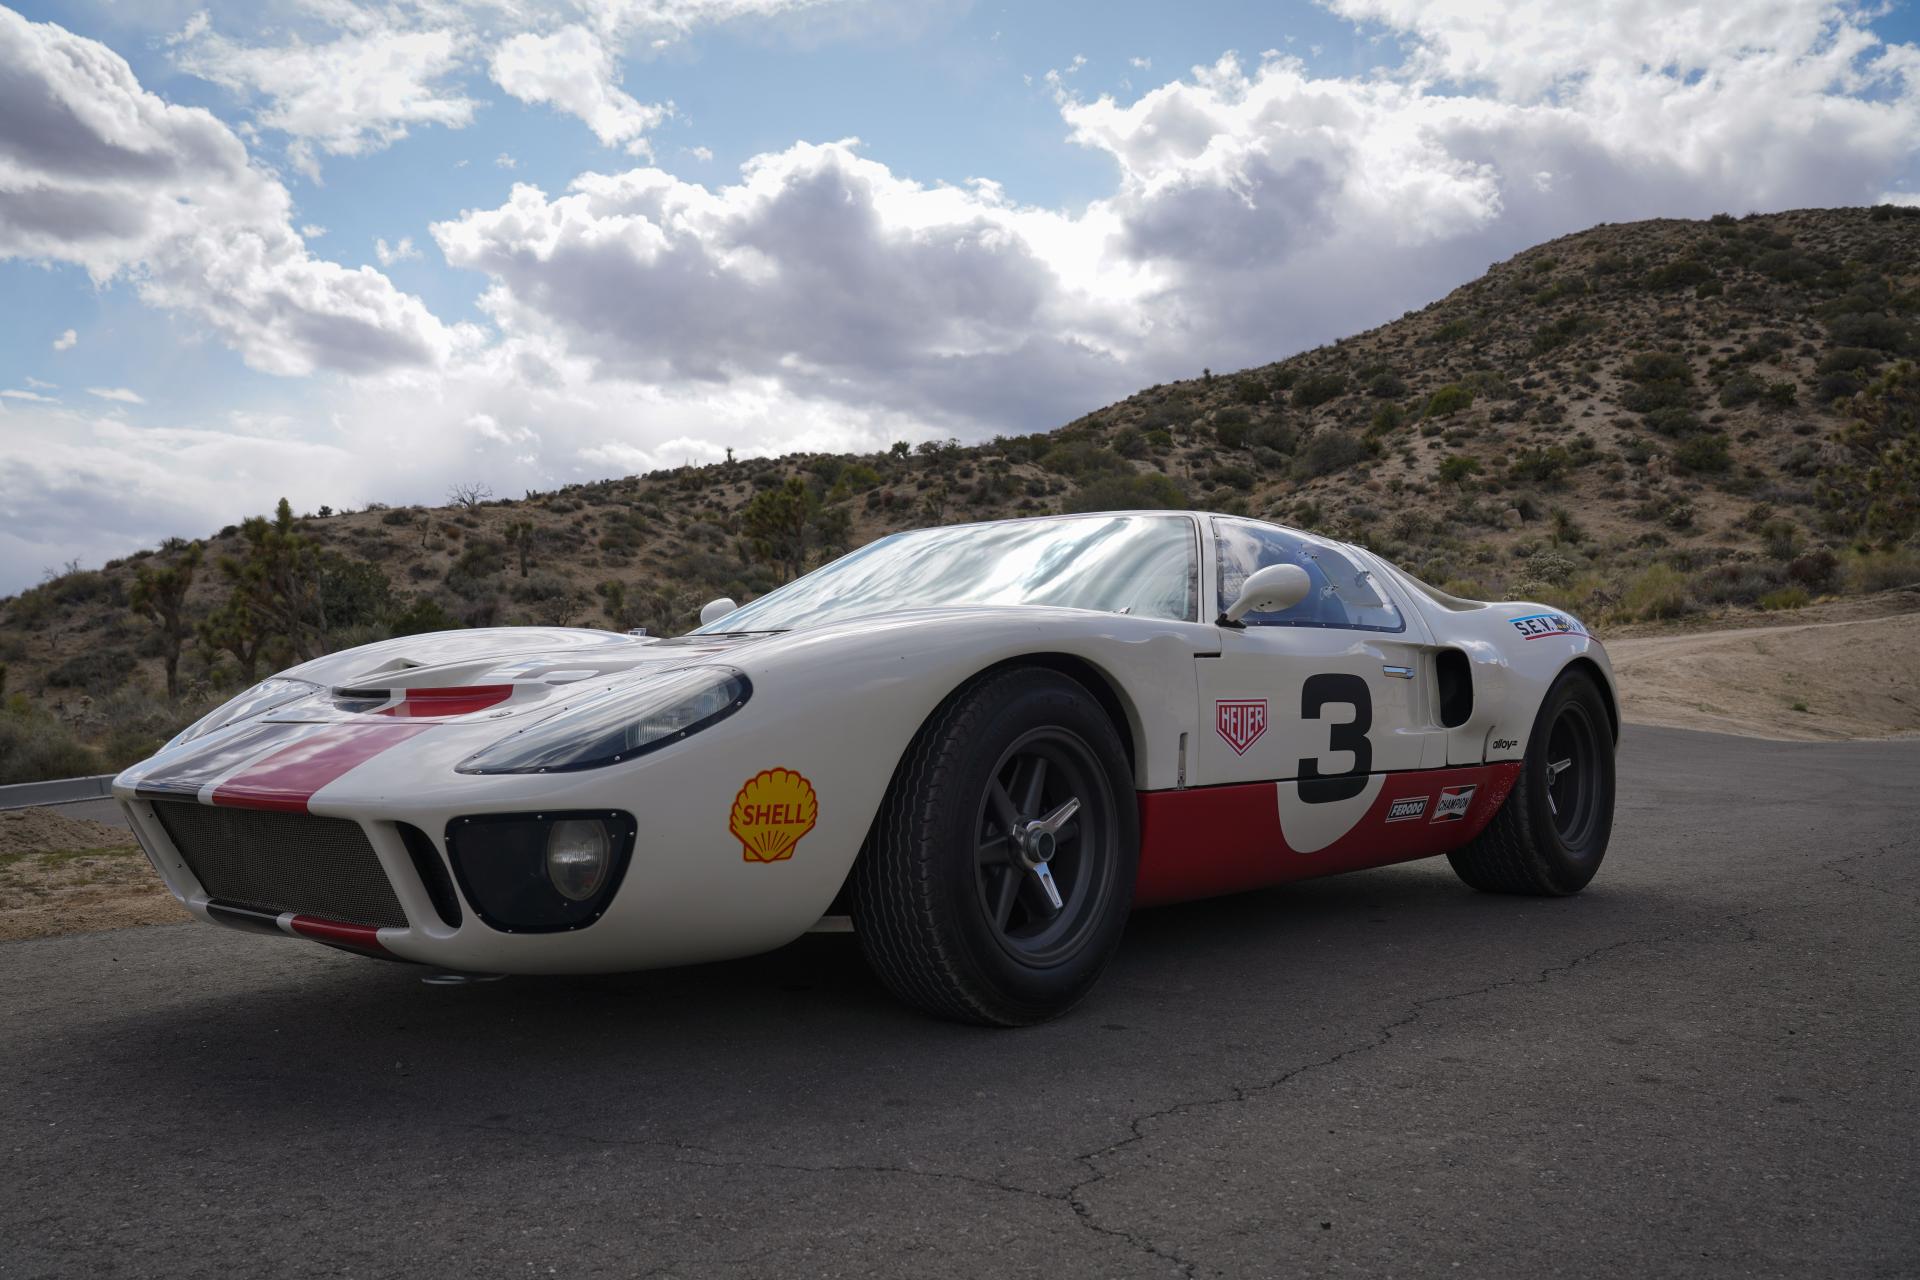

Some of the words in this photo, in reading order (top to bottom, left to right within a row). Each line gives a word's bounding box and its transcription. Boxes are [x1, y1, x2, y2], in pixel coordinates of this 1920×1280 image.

[1221, 707, 1264, 746] HEUER
[1298, 673, 1372, 804] 3
[742, 803, 807, 826] SHELL
[1390, 802, 1424, 817] FERODO
